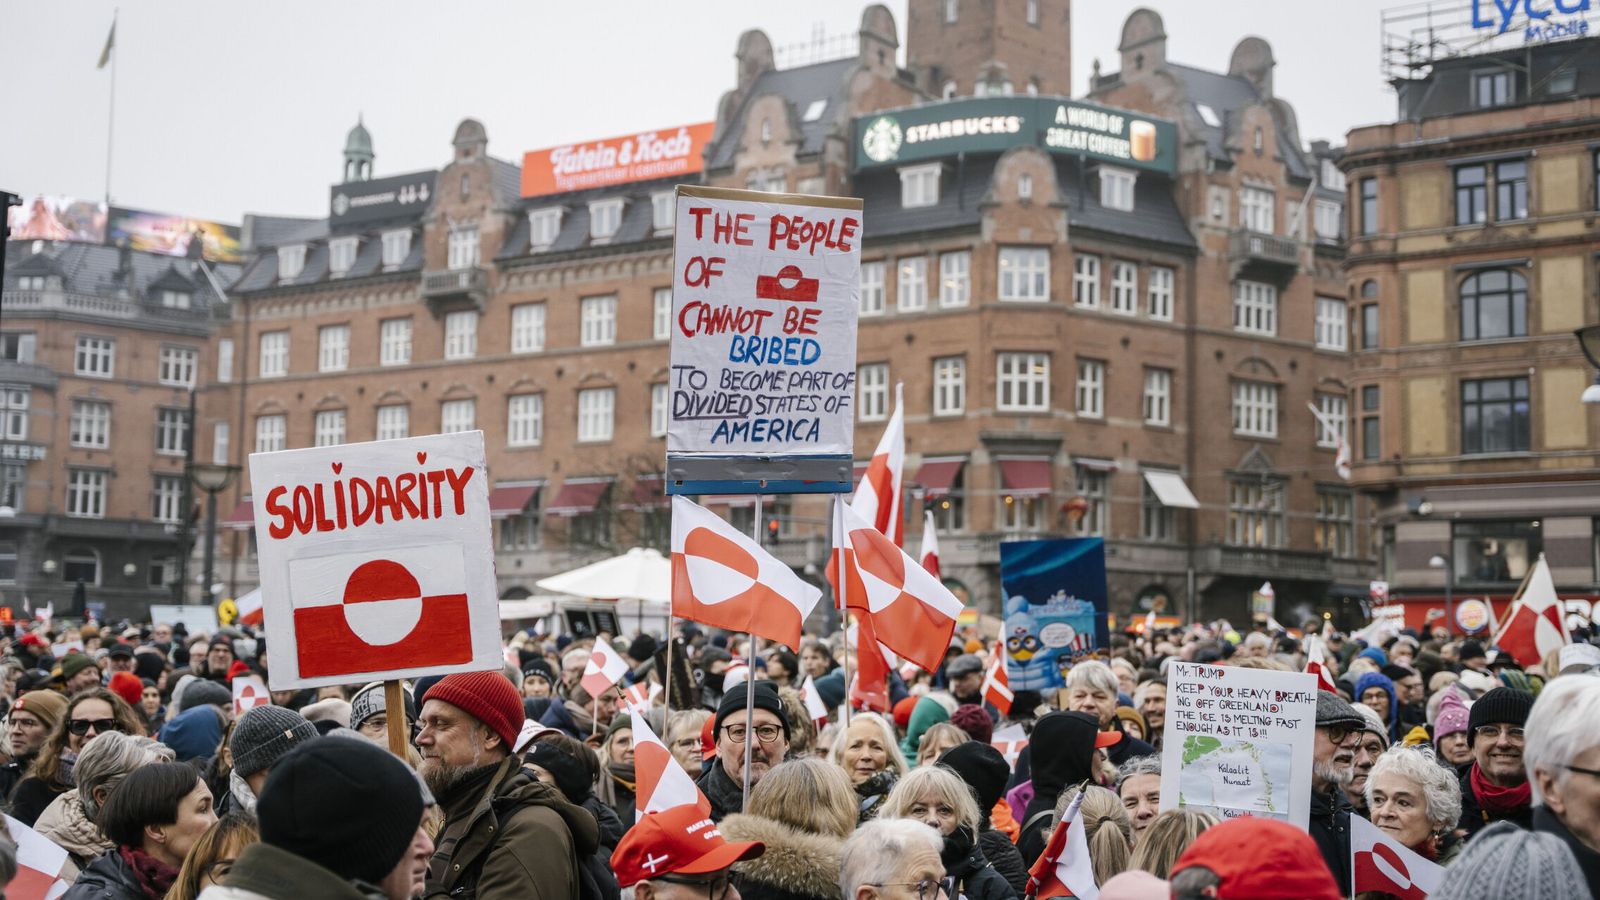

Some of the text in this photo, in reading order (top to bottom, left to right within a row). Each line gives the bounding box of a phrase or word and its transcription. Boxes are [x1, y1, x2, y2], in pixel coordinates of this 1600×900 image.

[906, 116, 1021, 143] STARBUCKS
[1055, 105, 1067, 125] A
[1067, 106, 1108, 132] WORLD
[634, 127, 692, 163] Koch
[689, 207, 860, 256] THE PEOPLE
[684, 255, 726, 289] OF
[678, 300, 823, 338] CANNOT BE
[729, 335, 821, 366] BRIBED
[672, 364, 708, 390] TO
[719, 367, 787, 392] BECOME
[754, 394, 821, 416] STATES
[824, 395, 851, 414] OF
[710, 417, 820, 444] AMERICA
[1175, 664, 1225, 680] Mr. TRUMP
[1175, 681, 1316, 704] KEEP YOUR HEAVY BREATH-
[1195, 698, 1215, 709] OFF
[1219, 699, 1284, 714] GREENLAND!
[1174, 710, 1196, 720] THE
[1233, 714, 1272, 727] MELTING
[1275, 717, 1302, 730] FAST
[1176, 721, 1213, 734] ENOUGH
[1216, 726, 1230, 736] AS
[1218, 763, 1250, 775] Kalaalit
[1223, 775, 1252, 786] Nunaat
